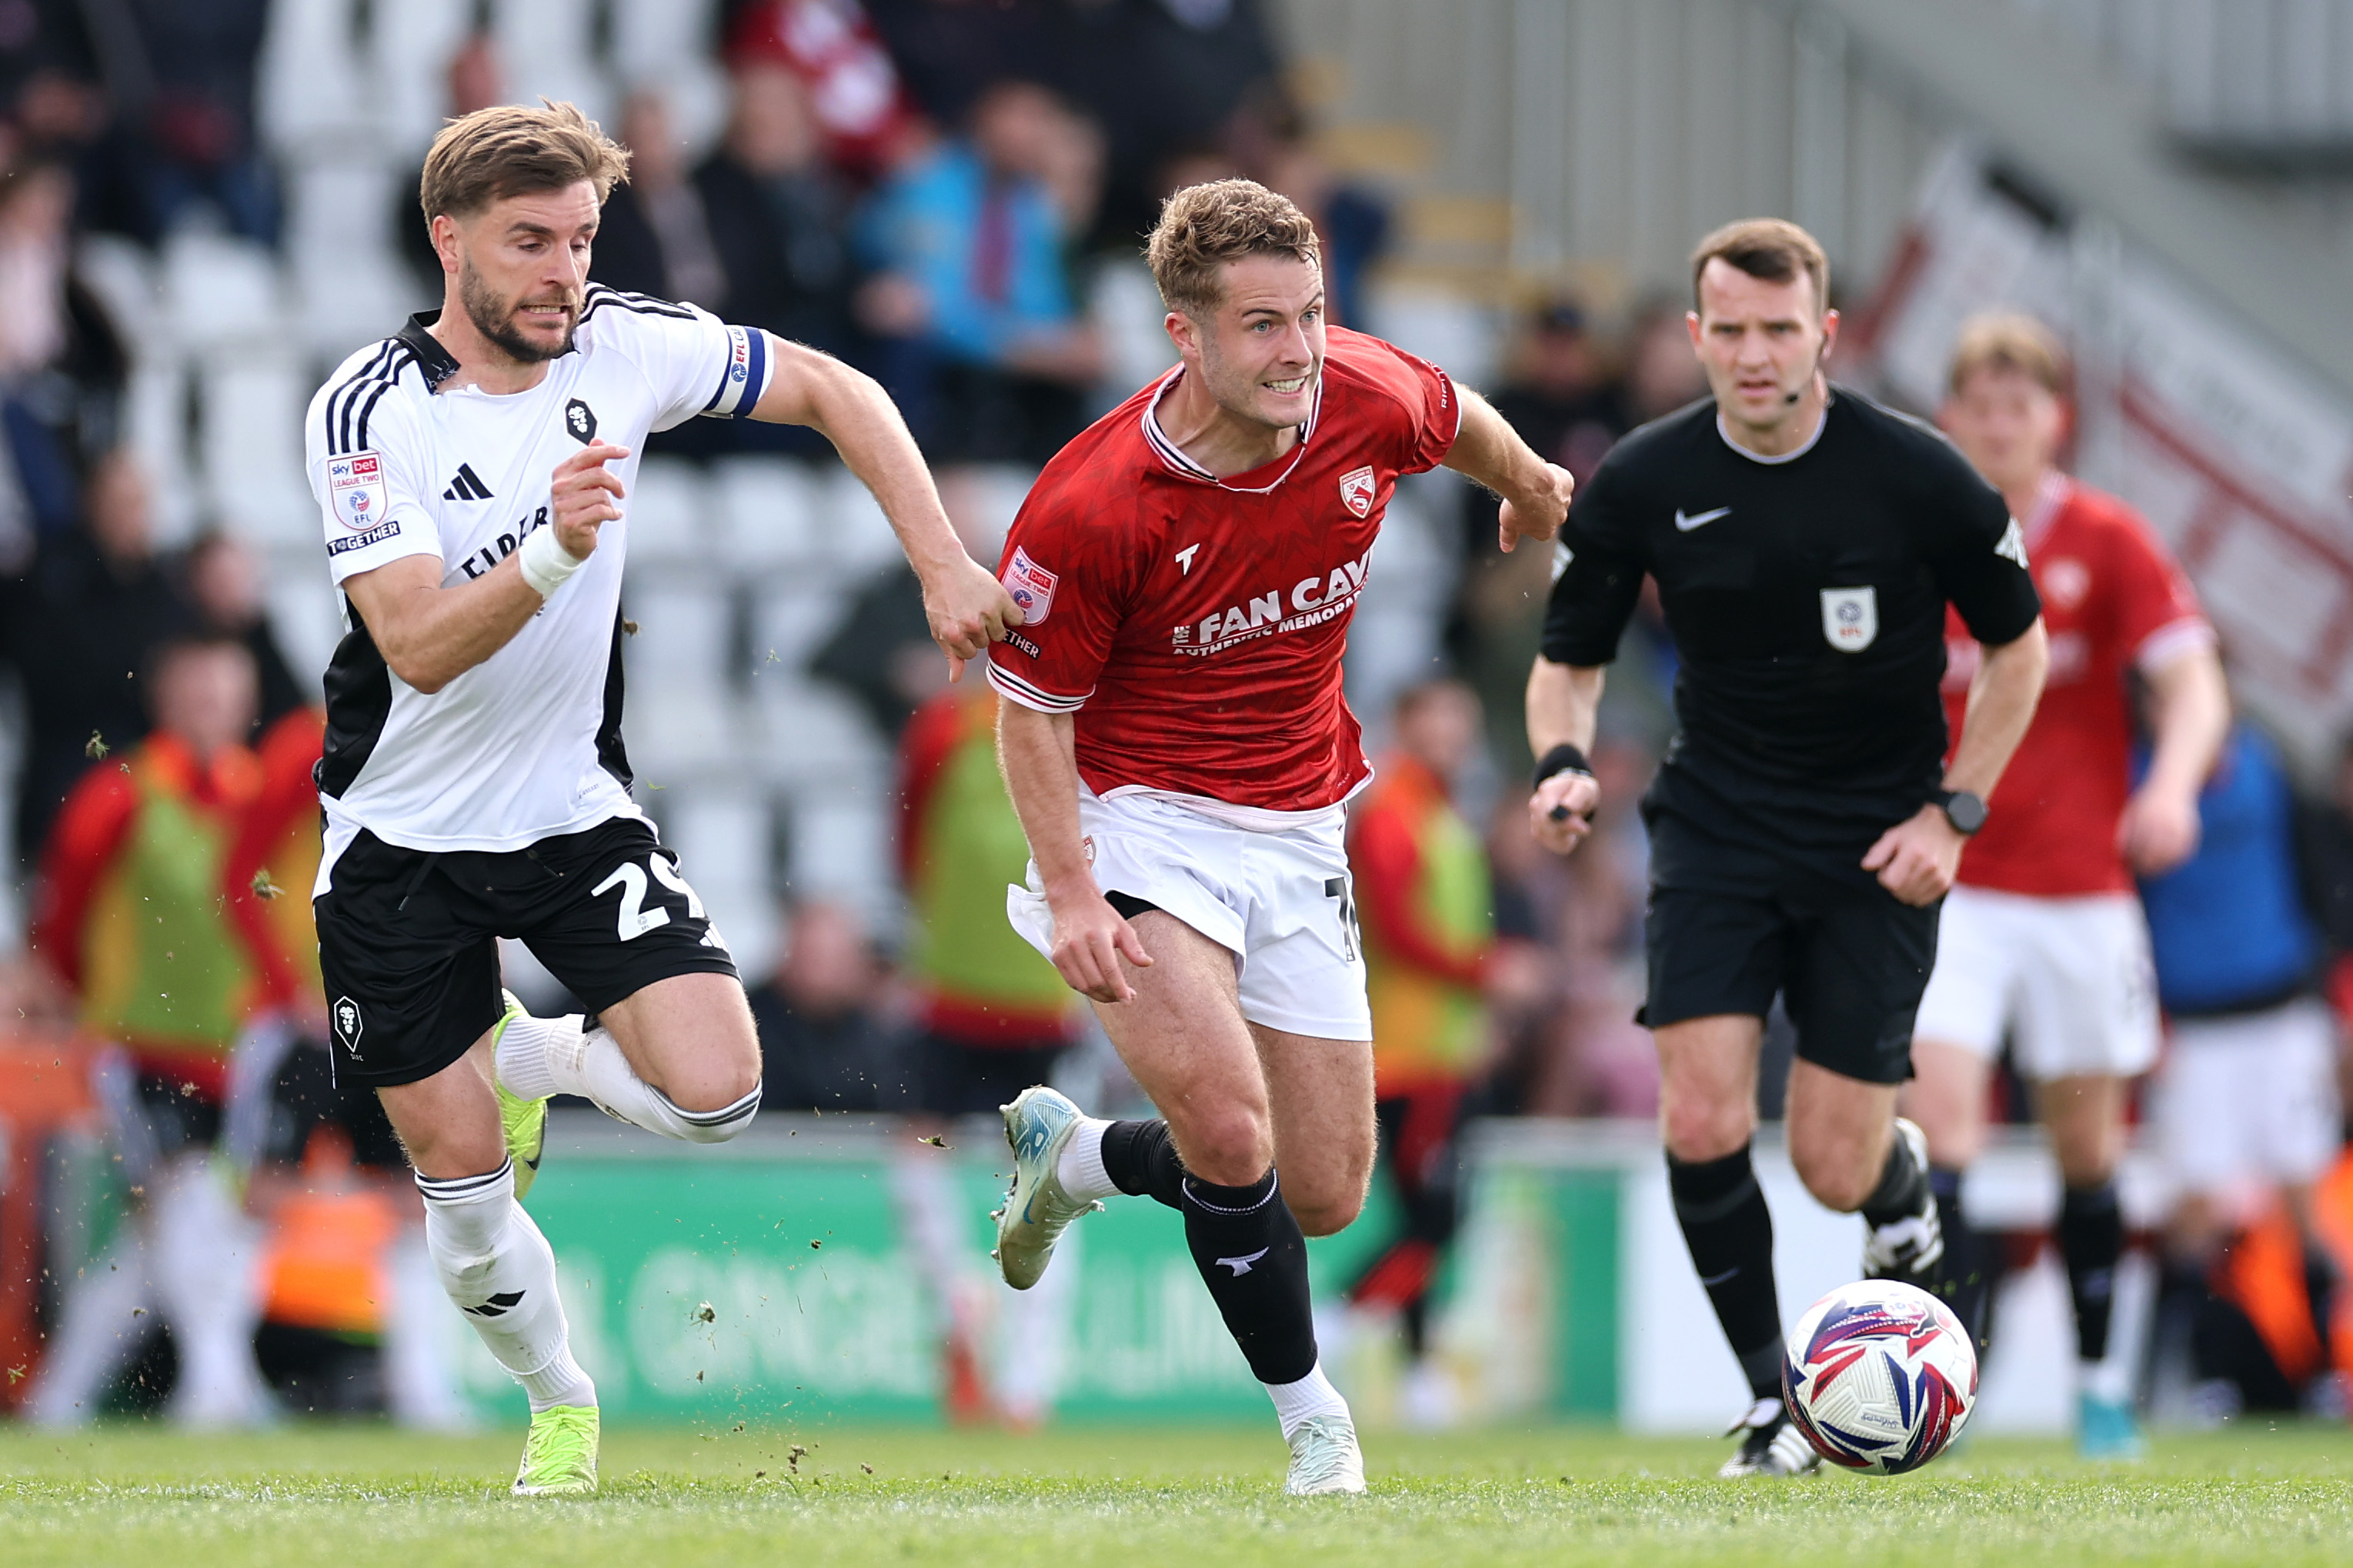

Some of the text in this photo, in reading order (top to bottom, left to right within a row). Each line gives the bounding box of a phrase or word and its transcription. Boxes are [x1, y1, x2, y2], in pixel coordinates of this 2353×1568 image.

[736, 344, 745, 362] EFL
[332, 459, 376, 475] sky bet
[333, 474, 379, 487] LEAGUE TWO
[354, 514, 371, 524] EFL
[329, 522, 399, 554] TOGETHER
[1010, 569, 1048, 596] LEAGUE TWO
[1014, 557, 1052, 586] sky bet
[1199, 543, 1373, 644] FAN CAV
